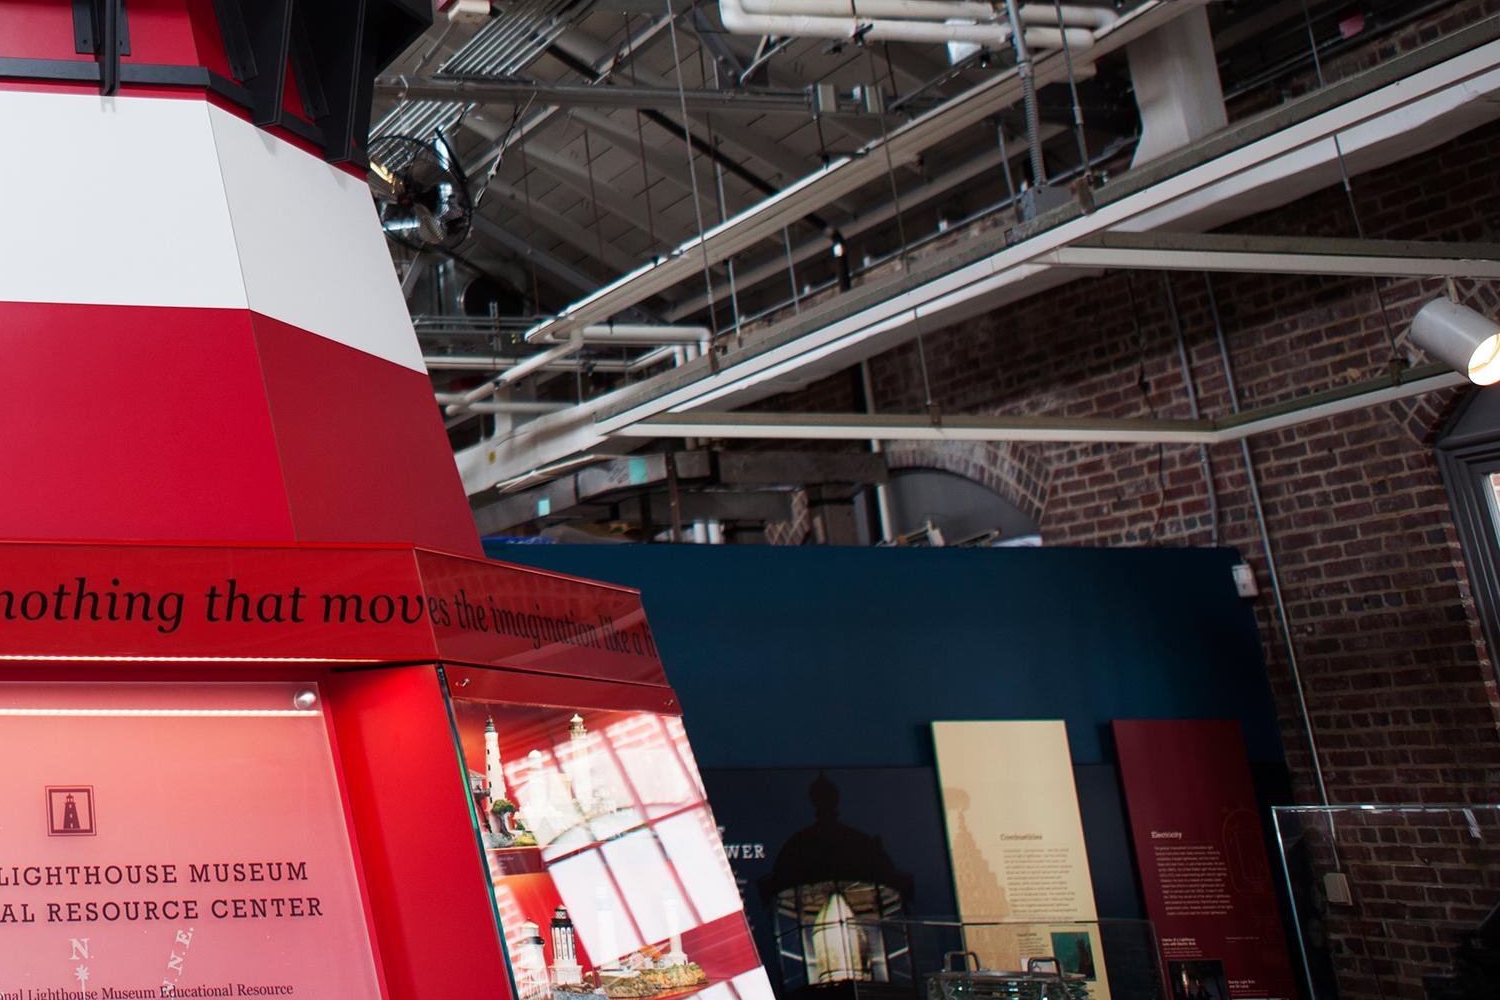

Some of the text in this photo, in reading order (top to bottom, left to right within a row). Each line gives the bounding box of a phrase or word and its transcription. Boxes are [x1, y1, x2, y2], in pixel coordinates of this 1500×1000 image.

[204, 579, 308, 624] that
[454, 589, 490, 633] the
[490, 599, 600, 649] imagination
[599, 615, 631, 654] like
[724, 843, 766, 859] WER
[189, 861, 309, 884] MUSEUM
[47, 901, 200, 924] RESOURCE
[211, 897, 324, 920] CENTER
[28, 988, 98, 1000] Lighthouse
[102, 987, 156, 999] Museum
[159, 984, 233, 999] Educational
[237, 983, 294, 998] Resource
